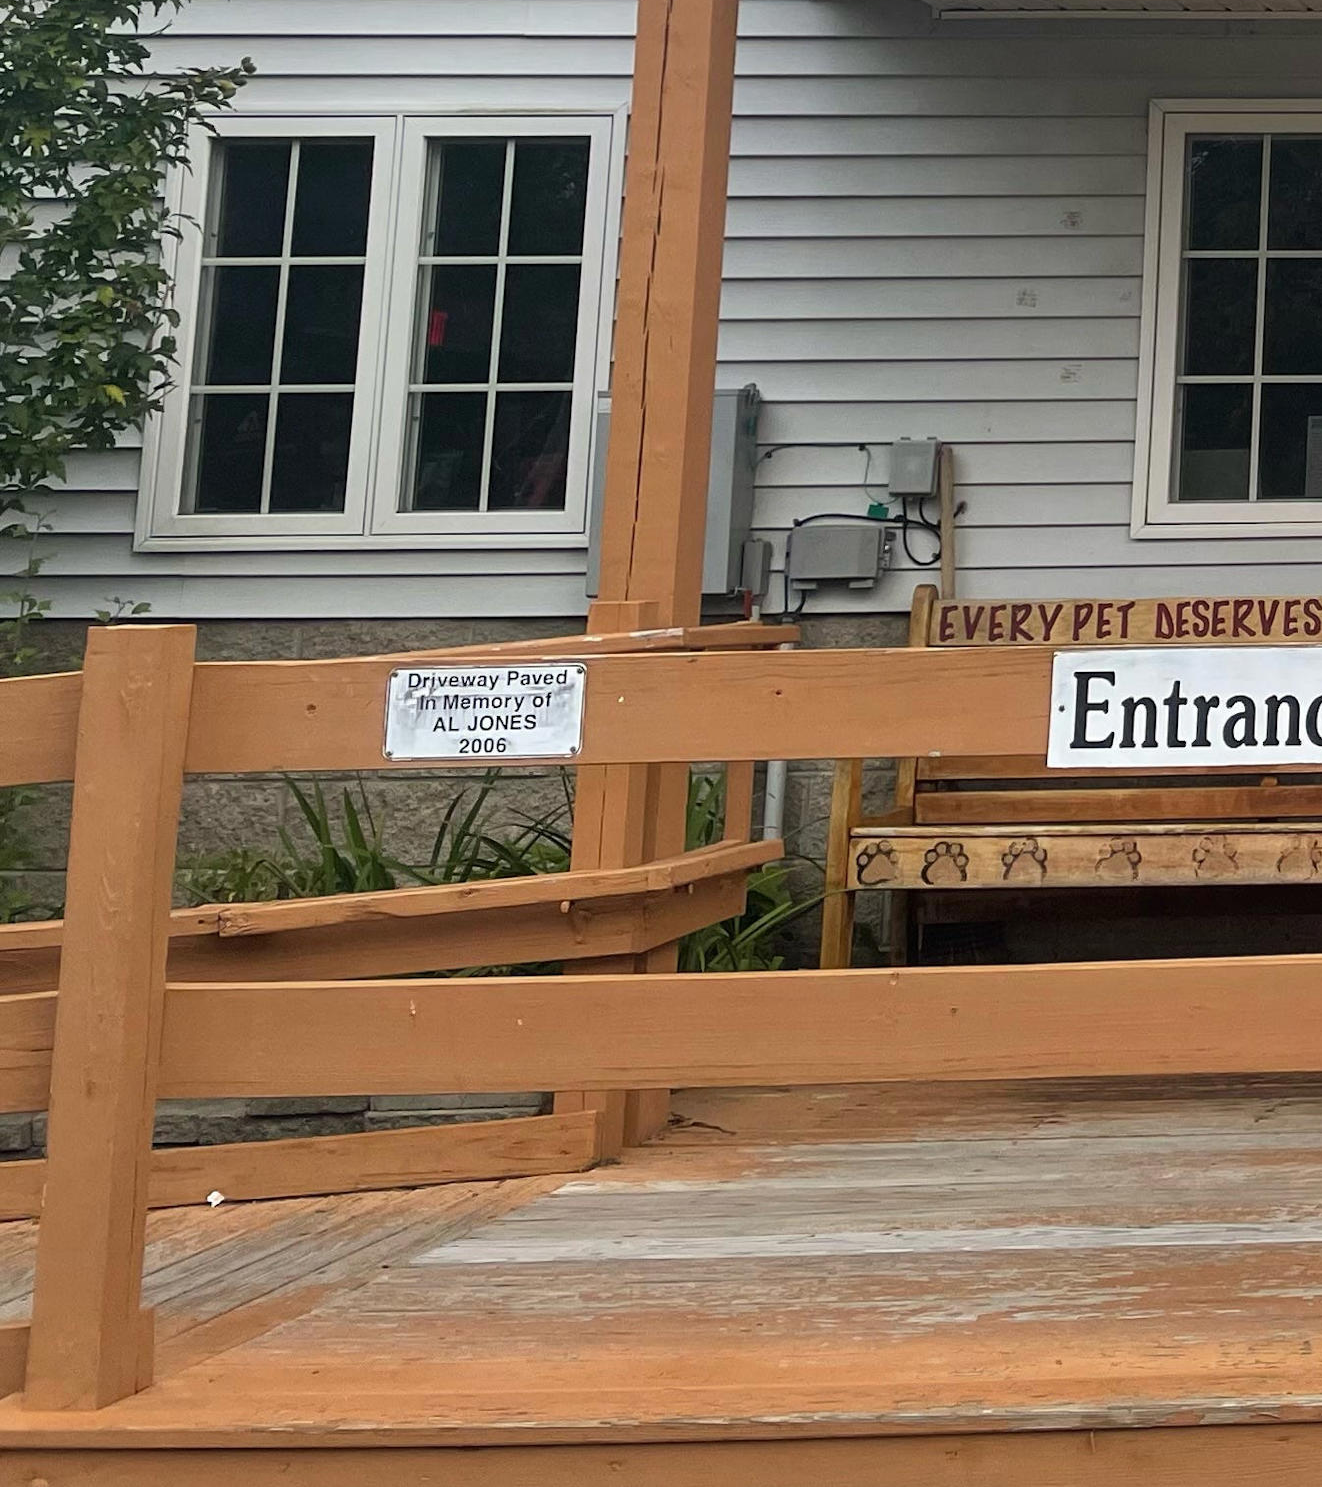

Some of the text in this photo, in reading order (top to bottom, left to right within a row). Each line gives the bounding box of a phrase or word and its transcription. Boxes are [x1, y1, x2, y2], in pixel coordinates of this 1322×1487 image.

[938, 603, 1063, 643] EVERY
[1072, 601, 1136, 641] PET
[1155, 600, 1322, 640] DESERVES
[408, 670, 568, 690] Driveway Paved
[420, 692, 552, 712] In Memory of
[432, 714, 537, 732] AL JONES
[459, 737, 507, 754] 2006
